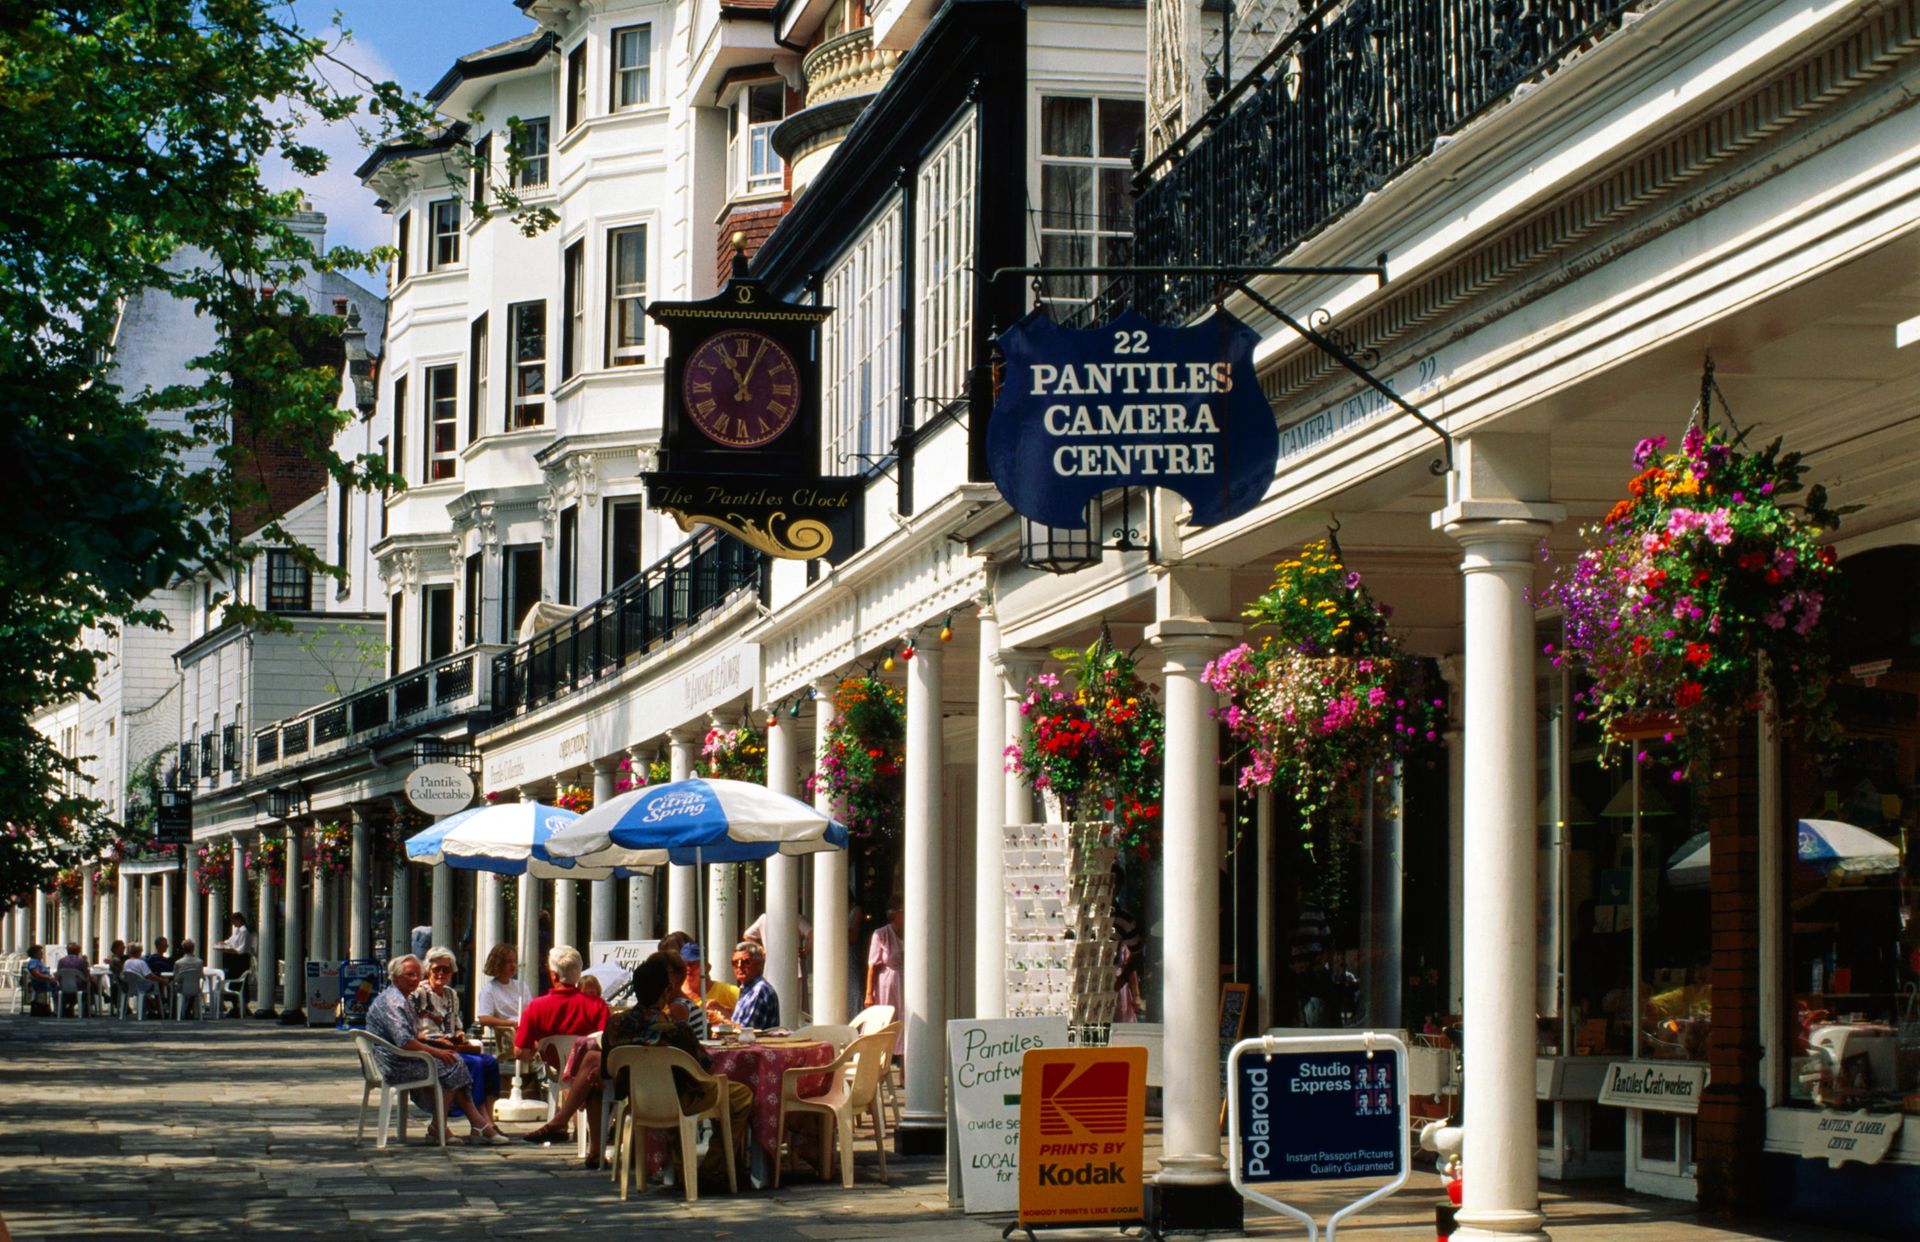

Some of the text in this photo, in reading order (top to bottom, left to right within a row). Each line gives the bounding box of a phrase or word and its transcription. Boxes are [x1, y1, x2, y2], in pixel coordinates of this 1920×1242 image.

[1113, 330, 1150, 354] 22
[1029, 361, 1233, 395] PANTILES
[1418, 356, 1440, 394] 22
[1043, 403, 1220, 436] CAMERA
[1282, 378, 1396, 461] CAMERA CENTRE
[1053, 444, 1215, 477] CENTRE
[656, 486, 850, 508] The Pantiles Clock
[420, 775, 462, 788] Pantiles
[410, 788, 471, 800] Collectables
[647, 794, 703, 812] Citrus
[642, 803, 706, 823] Spring
[615, 946, 639, 959] THE
[964, 1028, 1043, 1062] Pantiles
[1300, 1062, 1351, 1077] Studio
[1291, 1078, 1351, 1095] Express
[1612, 1066, 1643, 1094] Pantiles
[1247, 1068, 1271, 1176] Polaroid
[1004, 1133, 1018, 1146] of
[1040, 1142, 1126, 1156] PRINTS BY
[1286, 1149, 1394, 1163] Instant Passport Pictures
[972, 1154, 1017, 1169] LOCAL
[1310, 1161, 1394, 1175] Quality Guaranteed
[996, 1170, 1014, 1183] for
[1039, 1162, 1126, 1186] Kodak
[1023, 1206, 1139, 1217] NOBODY PRINTS LIKE KODAK
